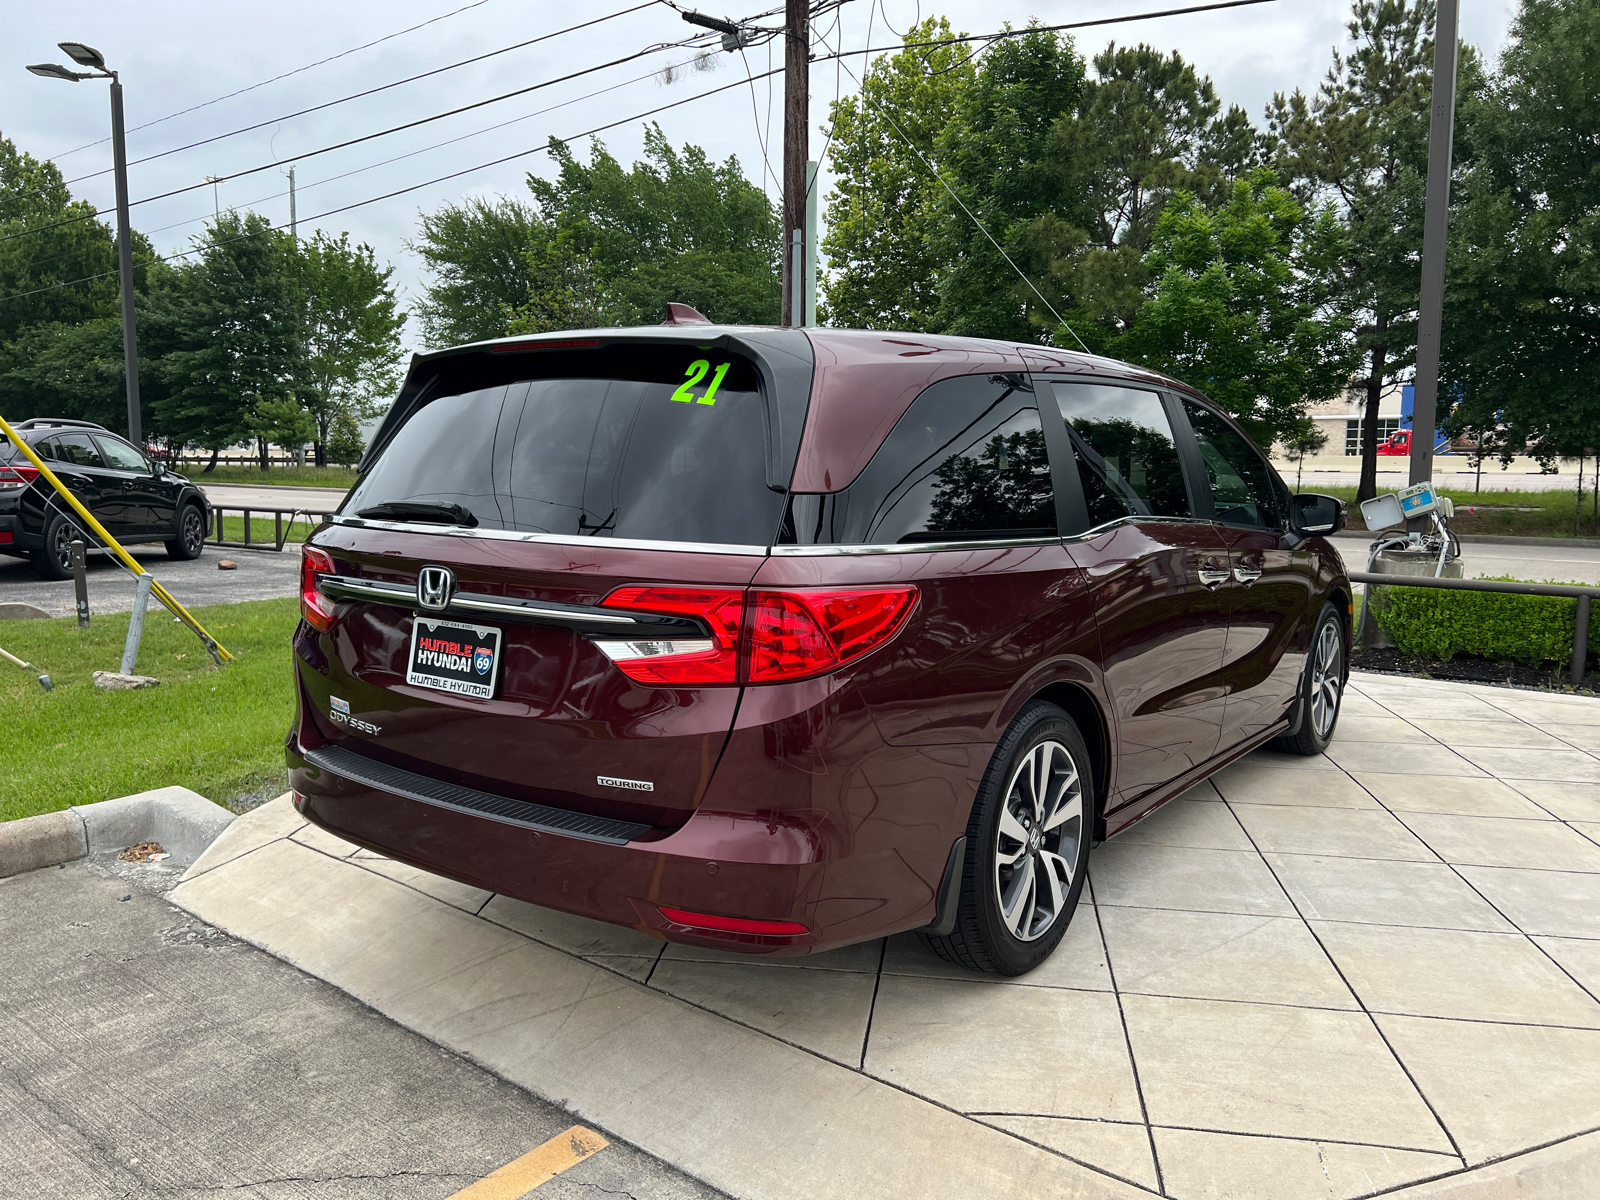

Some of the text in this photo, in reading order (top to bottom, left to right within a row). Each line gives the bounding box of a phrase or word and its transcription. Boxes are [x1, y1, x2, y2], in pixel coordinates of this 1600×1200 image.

[670, 359, 731, 405] 21
[419, 637, 473, 657] HUMBLE
[417, 649, 472, 673] HYUNDAI
[476, 657, 490, 670] 69
[410, 674, 491, 697] HUMBLE HYUNDAI
[330, 710, 382, 736] ODYSSEY
[599, 778, 651, 790] TOURING
